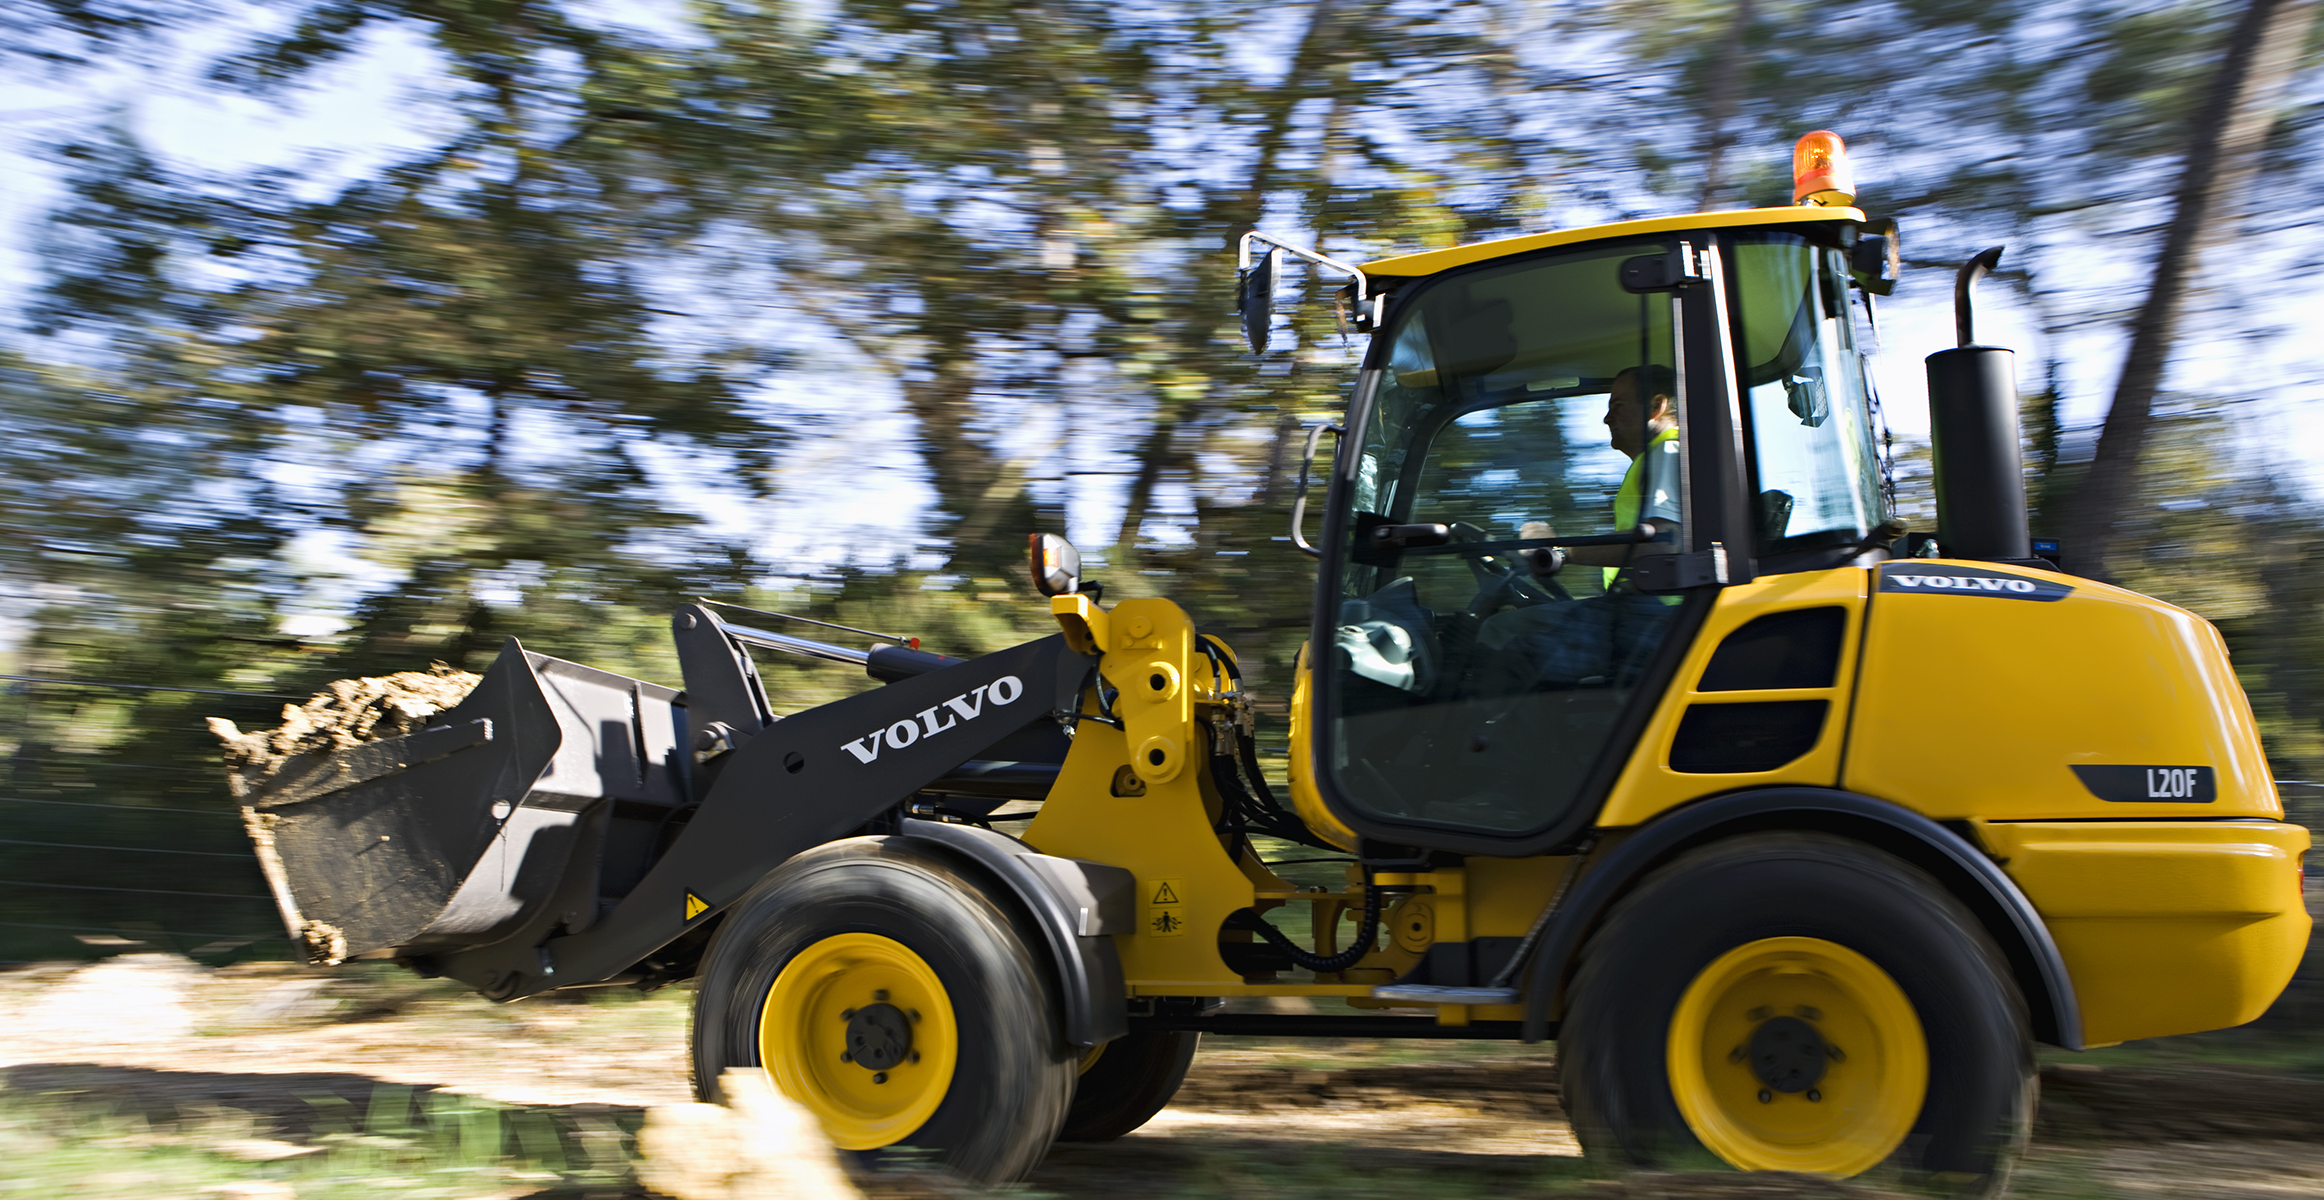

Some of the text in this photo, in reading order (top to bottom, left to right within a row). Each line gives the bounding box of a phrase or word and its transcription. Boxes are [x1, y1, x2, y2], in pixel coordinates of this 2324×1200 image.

[1887, 575, 2036, 593] VOLVO
[840, 675, 1024, 765] VOLVO
[2147, 768, 2198, 798] L20F
